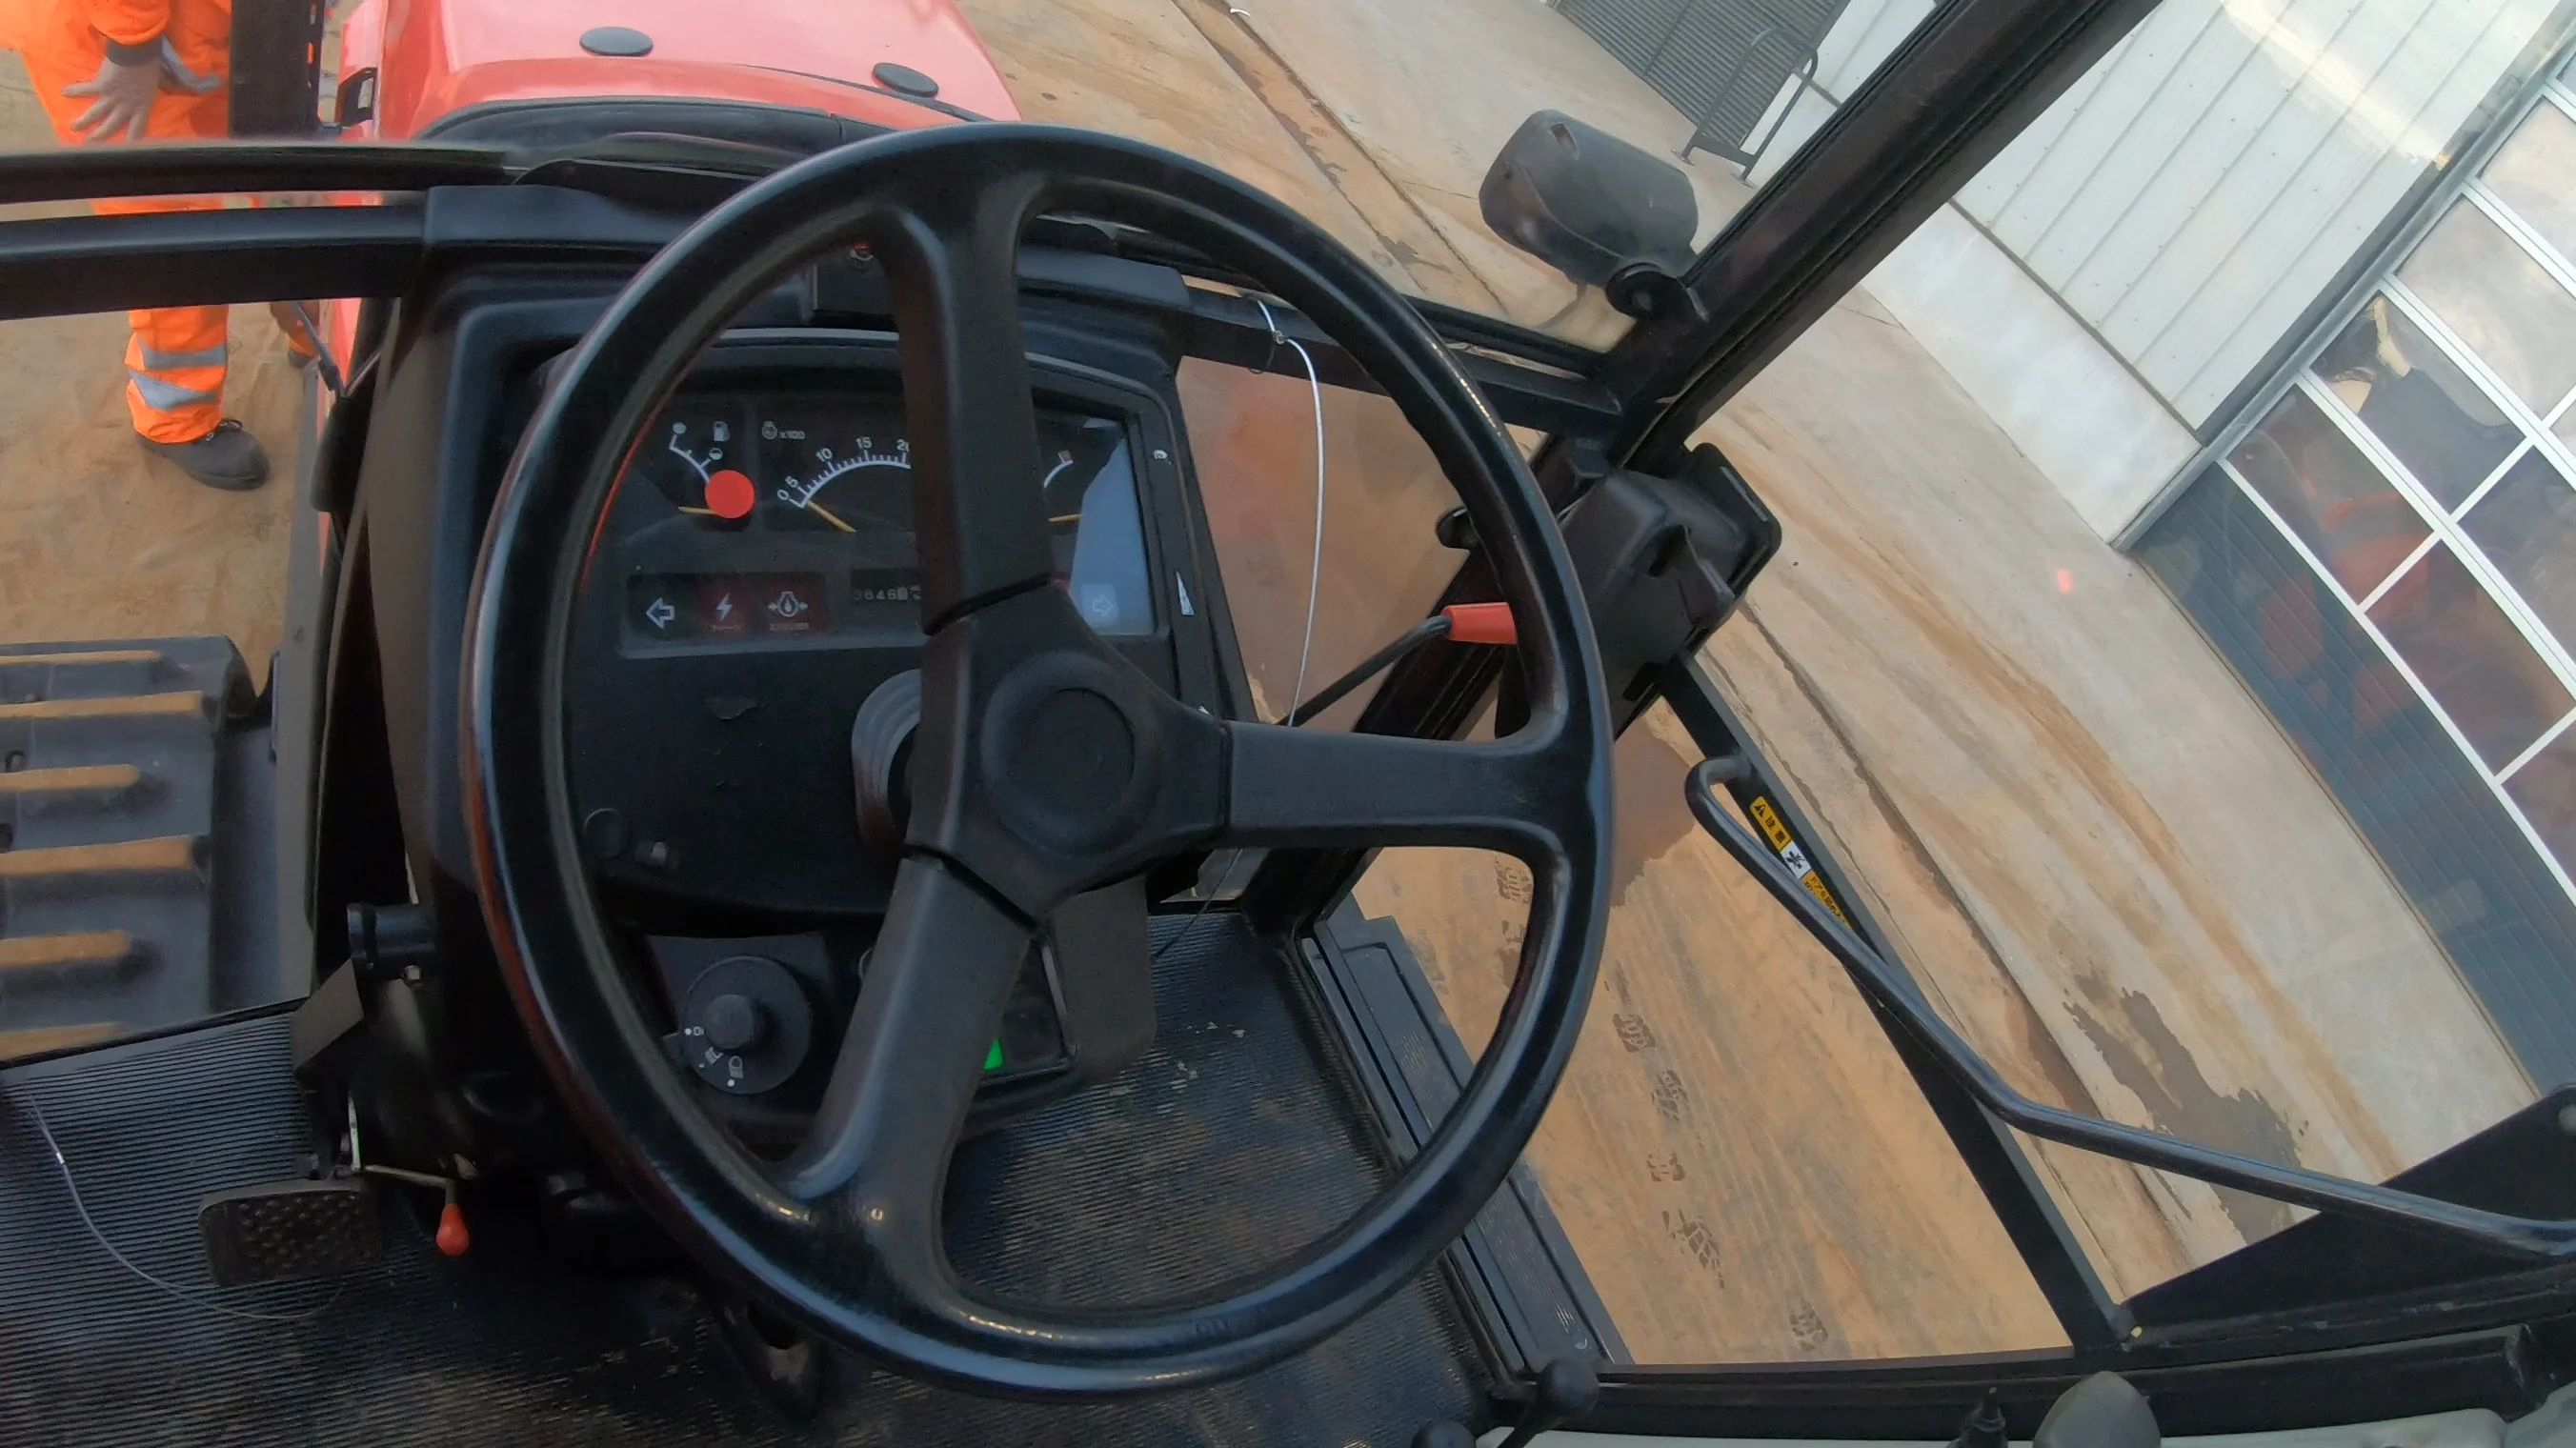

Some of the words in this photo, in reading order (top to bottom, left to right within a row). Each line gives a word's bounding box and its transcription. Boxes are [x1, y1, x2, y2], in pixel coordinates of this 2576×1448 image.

[856, 436, 872, 449] 15
[815, 447, 833, 462] 10
[784, 475, 798, 489] 5
[776, 489, 790, 500] 0
